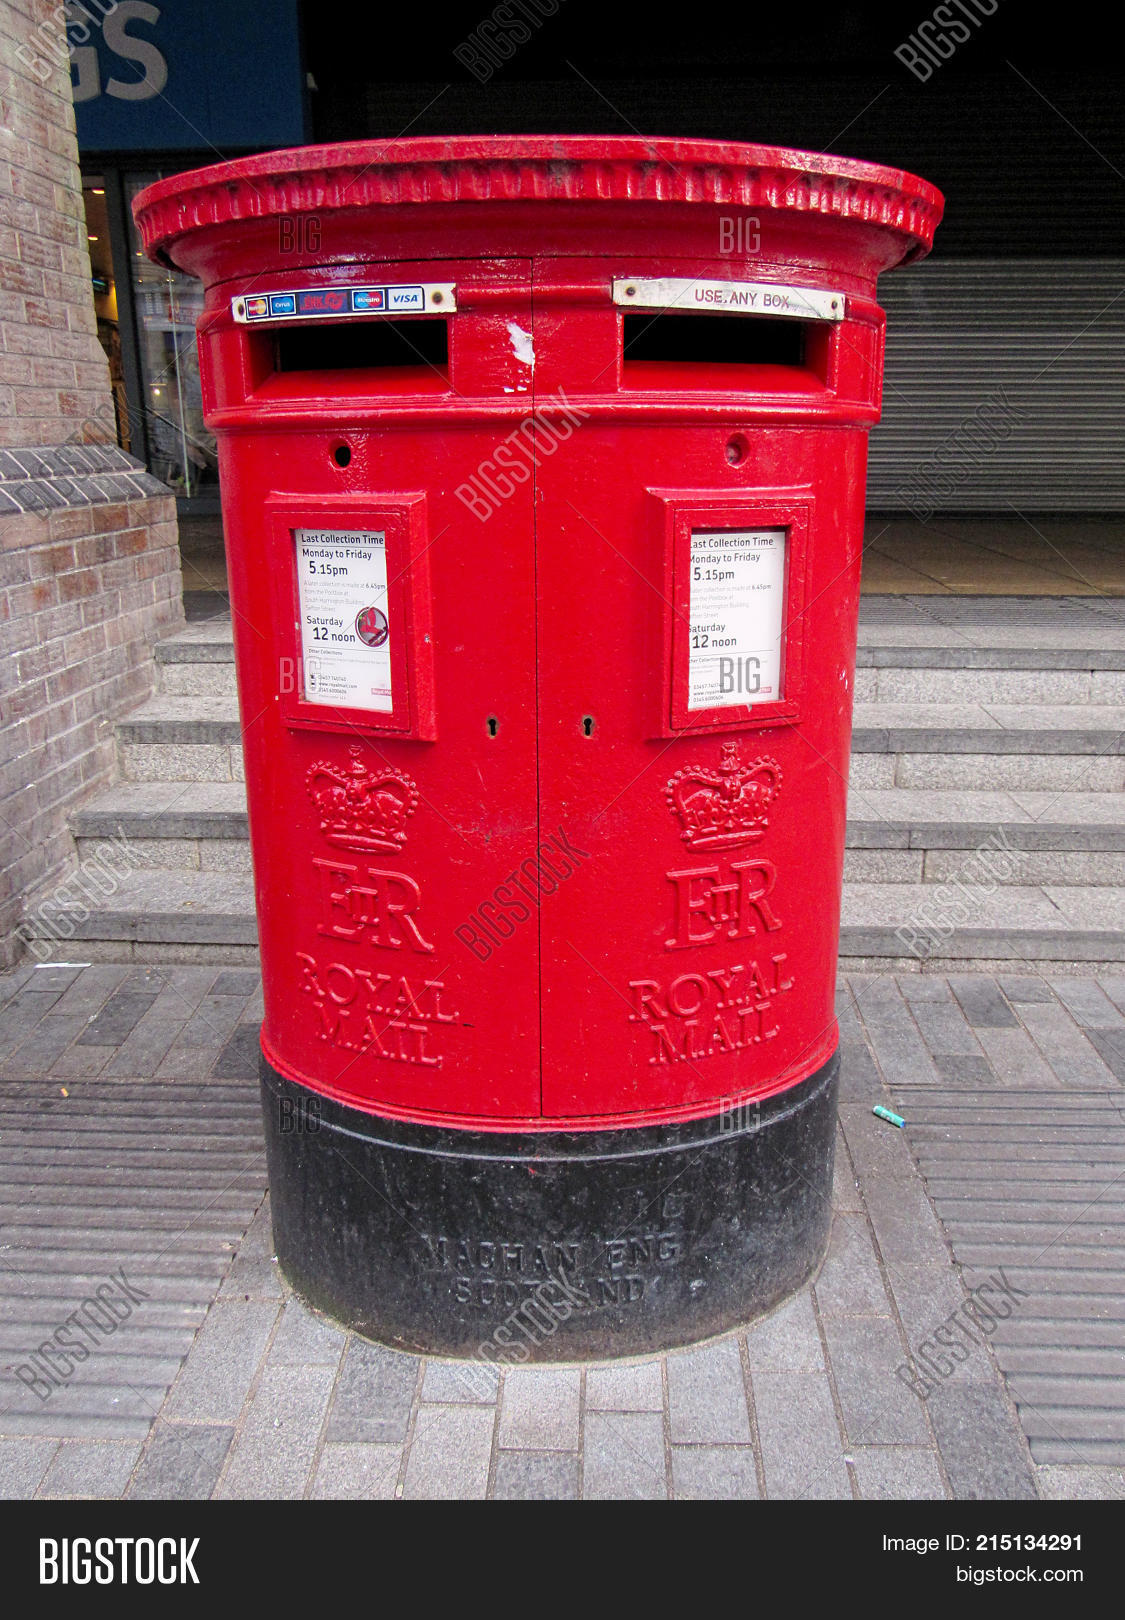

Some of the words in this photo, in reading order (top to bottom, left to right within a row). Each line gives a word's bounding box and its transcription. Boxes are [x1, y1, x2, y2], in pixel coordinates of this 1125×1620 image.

[393, 294, 418, 303] VISA
[729, 292, 757, 305] ANY
[763, 293, 789, 309] BOX
[301, 534, 318, 543] Last
[320, 534, 361, 544] Collection
[363, 535, 384, 545] Time
[690, 540, 706, 548] ast
[708, 538, 750, 548] Collection
[752, 537, 774, 546] Time
[302, 548, 334, 559] Monday
[346, 549, 372, 560] Friday
[734, 552, 761, 563] Friday
[309, 560, 348, 577] 5.15pm
[693, 567, 735, 581] 5.15pm
[306, 615, 343, 627] Saturday
[312, 626, 329, 640] 12
[331, 633, 356, 642] noon
[692, 634, 709, 649] 12
[711, 638, 737, 647] noon
[296, 951, 459, 1022] ROYAL
[628, 953, 795, 1021] ROYAL
[313, 1001, 442, 1068] MAIL
[649, 1001, 780, 1065] MAIL
[603, 1231, 681, 1268] ENG
